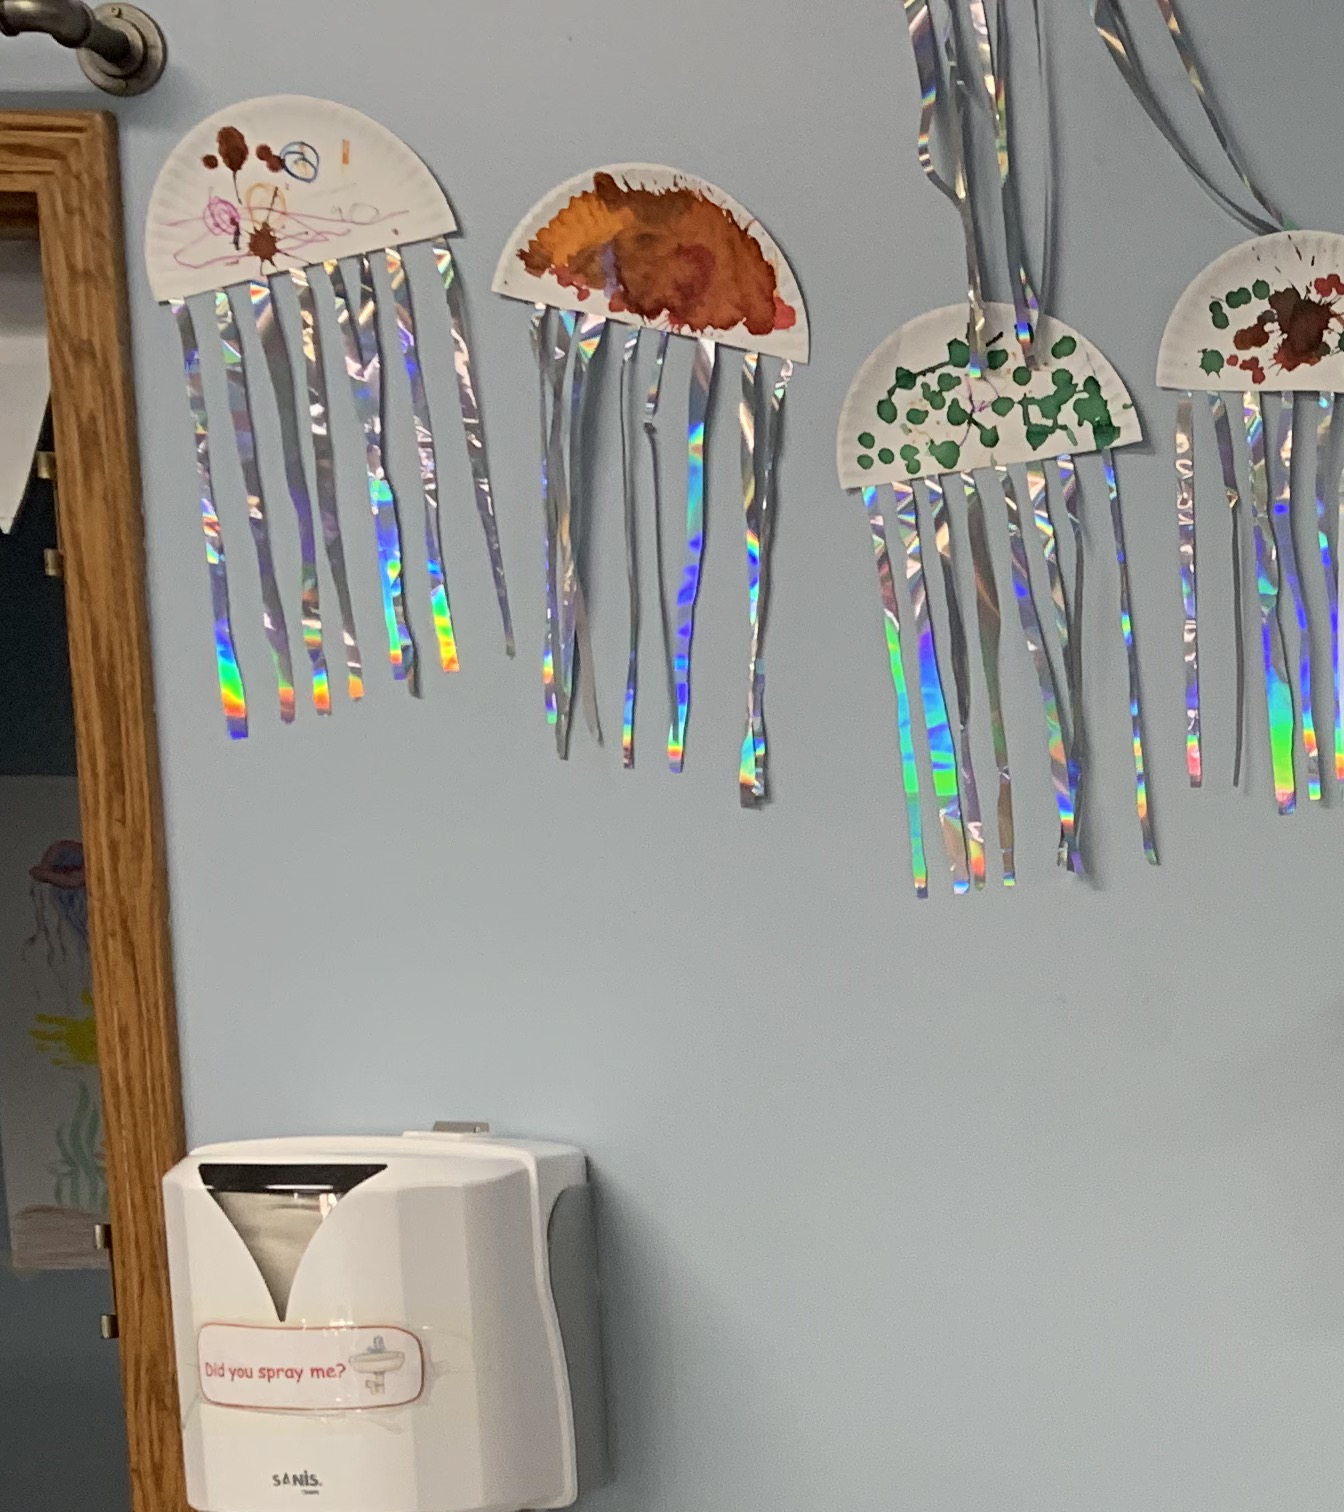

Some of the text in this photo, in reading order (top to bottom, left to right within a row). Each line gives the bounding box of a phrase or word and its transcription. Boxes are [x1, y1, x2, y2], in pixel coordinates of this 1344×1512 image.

[204, 1362, 347, 1383] Did you spray me?
